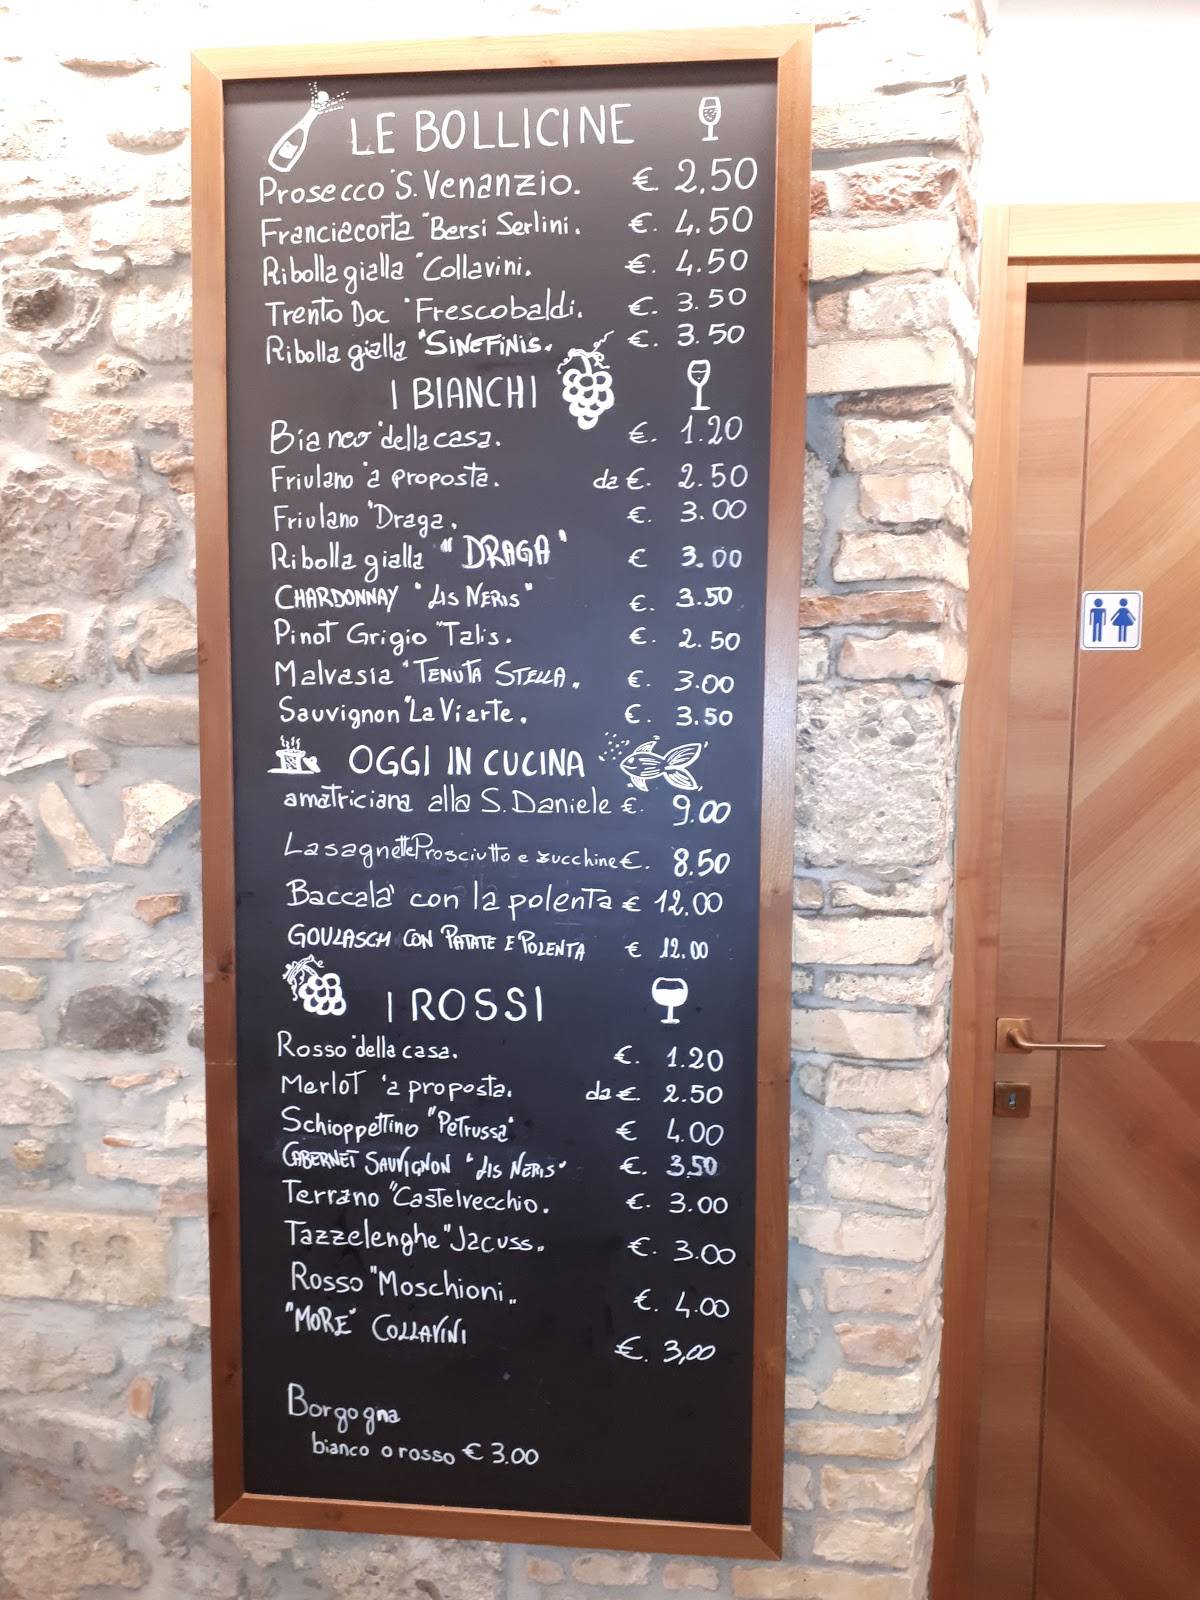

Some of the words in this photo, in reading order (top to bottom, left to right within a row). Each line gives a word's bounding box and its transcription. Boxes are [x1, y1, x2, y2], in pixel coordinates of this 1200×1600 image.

[350, 111, 396, 156] LE
[415, 103, 635, 153] BOLLICINE
[259, 175, 385, 207] Prosecco
[673, 157, 758, 195] 2.50
[260, 211, 415, 248] Franciacorta
[674, 205, 754, 237] 4.50
[262, 252, 340, 287] Ribolla
[343, 251, 405, 295] gialla
[675, 247, 749, 277] 4.50
[676, 287, 747, 313] 3.50
[265, 334, 342, 365] Ribolla
[347, 332, 409, 372] gialla
[676, 322, 746, 347] 3.50
[390, 379, 398, 411] I
[412, 374, 537, 411] BIANCHI
[680, 414, 743, 445] 1.20
[271, 463, 354, 493] Friulano
[592, 468, 620, 490] da
[677, 462, 749, 490] 2.50
[273, 501, 359, 532] Friulano
[679, 498, 748, 523] 3.00
[270, 540, 358, 571] Ribolla
[363, 541, 425, 584] gialla
[627, 548, 648, 568] €
[680, 545, 743, 569] 3.00
[675, 586, 733, 608] 3.50
[346, 622, 428, 657] Grigio
[678, 627, 741, 652] 2.50
[274, 658, 395, 688] Malvasia
[673, 670, 735, 695] 3.00
[278, 695, 400, 730] Sauvignon
[675, 705, 734, 727] 3.50
[348, 744, 430, 778] OGGI
[446, 745, 472, 776] IN
[483, 747, 586, 778] CUCINA
[283, 783, 414, 813] amatriciana
[427, 783, 471, 813] alla
[511, 785, 613, 815] Daniele
[672, 793, 732, 827] 9.00
[517, 854, 529, 863] e
[535, 847, 619, 869] zucchine
[673, 847, 731, 878] 8.50
[409, 892, 459, 910] con
[473, 879, 501, 912] la
[507, 883, 613, 922] polenta
[621, 895, 642, 913] €
[653, 889, 724, 917] 12.00
[402, 928, 434, 950] CON
[439, 923, 497, 951] PATATE
[503, 935, 516, 952] E
[517, 929, 586, 962] POLENTA
[623, 941, 642, 958] €
[658, 936, 709, 961] 12.00
[387, 991, 393, 1024] I
[411, 985, 543, 1023] ROSSI
[276, 1029, 347, 1058] Rosso
[666, 1045, 724, 1073] 1.20
[584, 1079, 613, 1101] da
[662, 1083, 724, 1105] 2.50
[615, 1120, 638, 1142] €
[666, 1117, 725, 1147] 4.00
[281, 1140, 361, 1170] CABERNET
[364, 1145, 451, 1178] SAUVIGNON
[665, 1154, 718, 1177] 3.50
[281, 1178, 380, 1208] Terrano
[668, 1191, 729, 1215] 3.00
[283, 1217, 441, 1257] Tazzelenghe
[672, 1239, 737, 1266] 3.00
[291, 1260, 364, 1294] Rosso
[674, 1290, 731, 1319] 4.00
[371, 1313, 467, 1345] COLLAVINI
[662, 1339, 717, 1366] 3,00
[287, 1381, 402, 1436] Borgogna
[311, 1430, 370, 1457] bianco
[380, 1445, 394, 1458] o
[398, 1446, 456, 1466] rosso
[460, 1442, 485, 1461] €
[490, 1441, 540, 1466] 3.00
